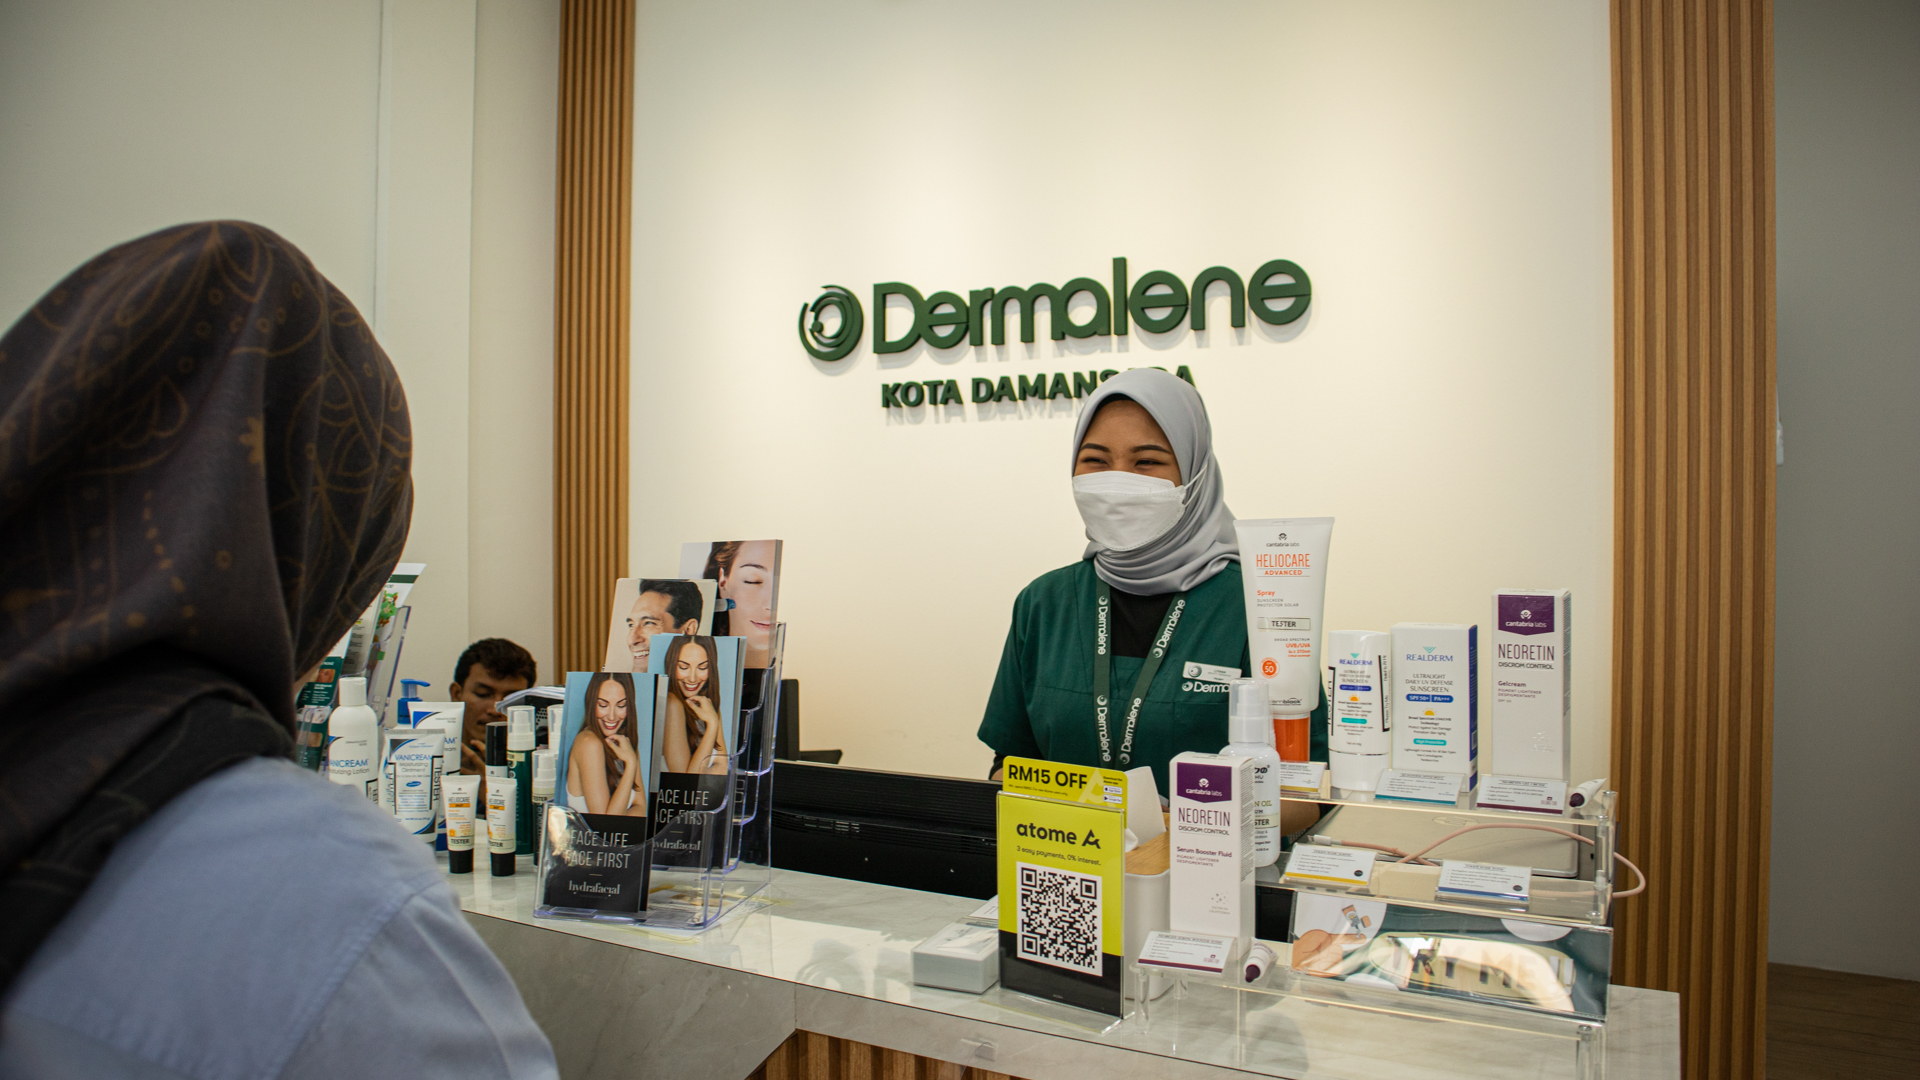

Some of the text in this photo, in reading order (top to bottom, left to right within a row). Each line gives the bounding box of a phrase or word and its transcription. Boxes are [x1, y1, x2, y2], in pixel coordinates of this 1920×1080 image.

[872, 257, 1312, 355] Dermalene
[881, 379, 963, 408] KOTA
[1256, 554, 1310, 567] HELIOCARE
[1257, 589, 1275, 597] Spray
[1098, 606, 1108, 655] Dermalene
[1156, 599, 1185, 648] Dermalene
[1271, 620, 1296, 628] TESTER
[1498, 644, 1554, 660] NEORETIN
[1193, 681, 1230, 693] Derma
[1120, 698, 1141, 752] Dermalene
[1097, 707, 1111, 762] Dermalene
[329, 759, 368, 768] ANICREAM
[1008, 764, 1087, 789] RM15 OFF
[658, 789, 709, 805] ACE LIFE
[1178, 807, 1230, 827] NEORETIN
[570, 830, 629, 848] FACE LIFE
[1016, 823, 1077, 845] atome
[564, 850, 631, 868] FACE FIRST
[568, 880, 621, 897] hydrafacial
